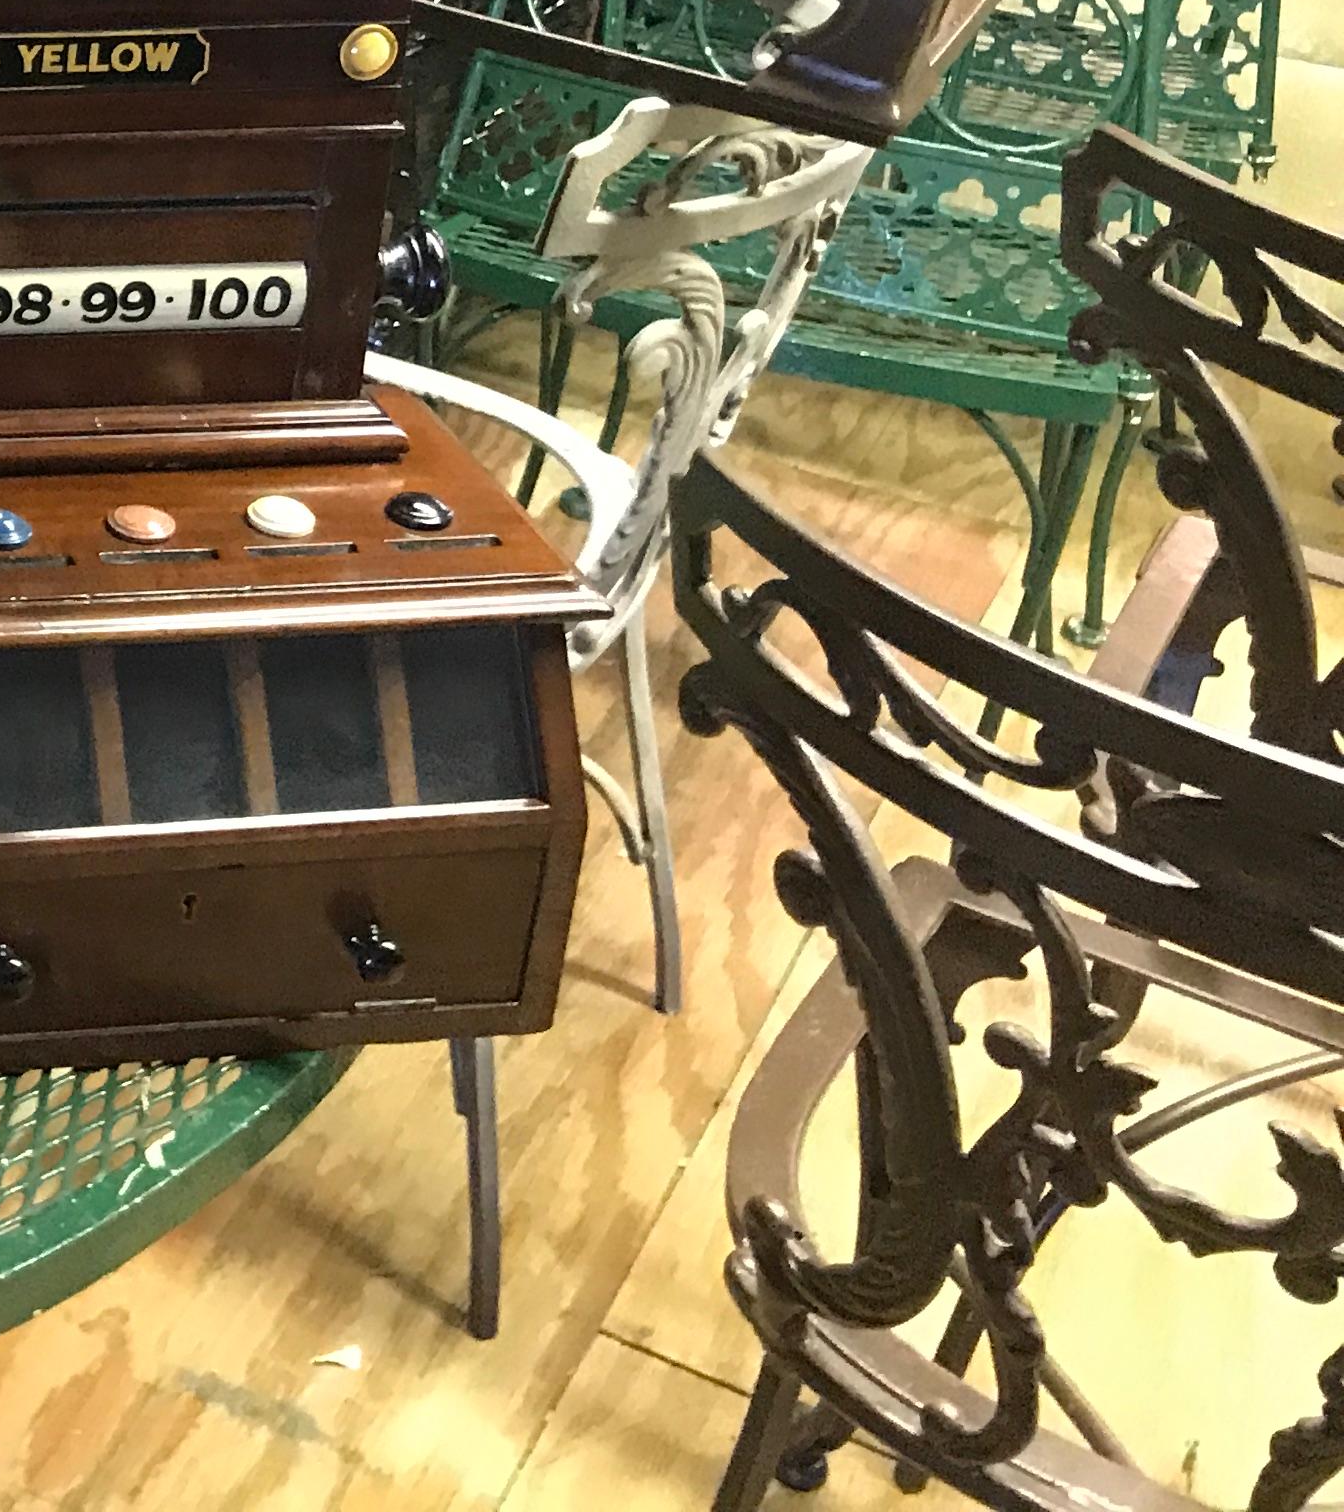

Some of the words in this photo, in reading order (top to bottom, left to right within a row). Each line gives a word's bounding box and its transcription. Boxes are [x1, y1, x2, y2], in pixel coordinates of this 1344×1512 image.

[18, 41, 180, 74] YELLOW
[81, 280, 156, 323] 99
[188, 276, 292, 320] 100
